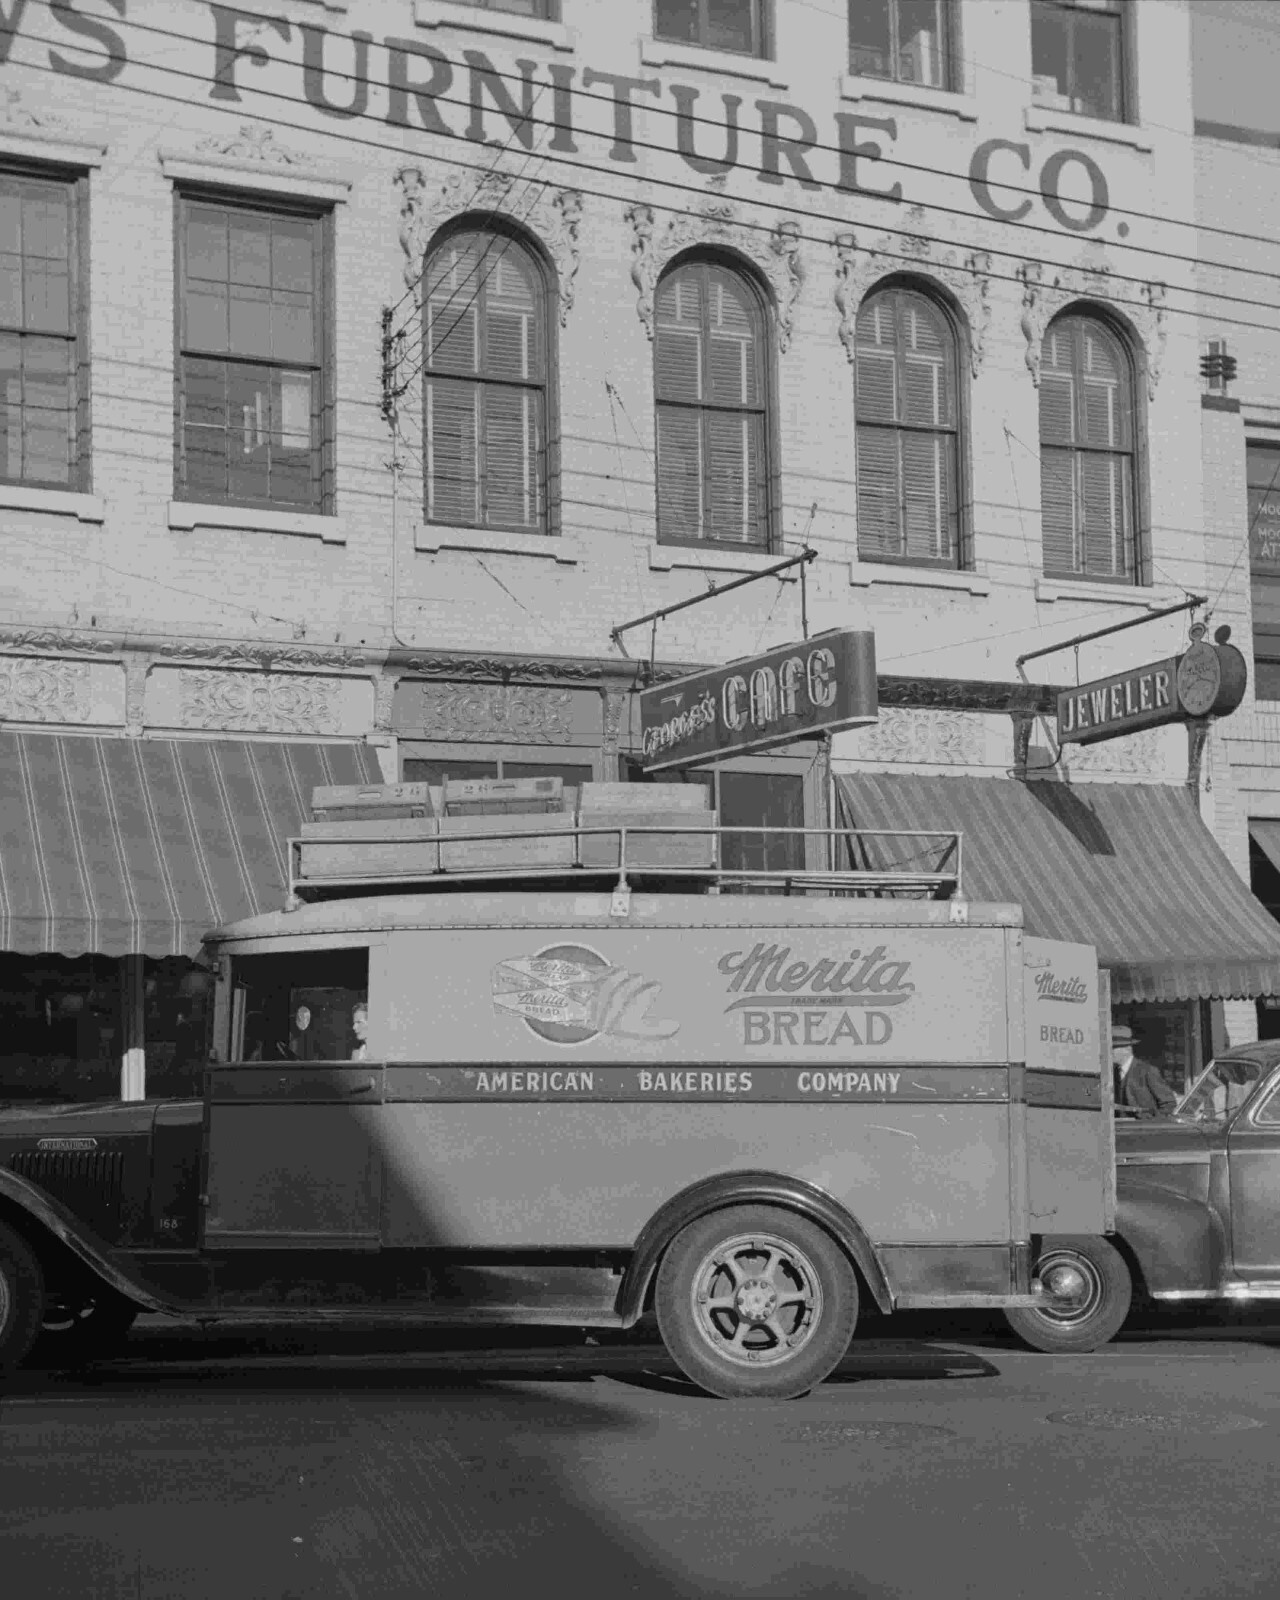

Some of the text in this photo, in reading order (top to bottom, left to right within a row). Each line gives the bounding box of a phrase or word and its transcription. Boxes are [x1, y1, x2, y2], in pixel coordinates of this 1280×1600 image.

[208, 3, 903, 204] FURNITURE
[969, 137, 1130, 238] CO.
[722, 648, 837, 732] CAFE
[1062, 670, 1170, 732] JEWELER
[717, 943, 916, 993] Merita
[517, 991, 569, 1007] Merita
[1034, 971, 1088, 999] Merita
[524, 1005, 561, 1015] BREAD
[743, 1011, 894, 1046] BREAD
[1040, 1024, 1085, 1045] BREAD
[475, 1070, 901, 1093] AMERICAN BAKERIES COMPANY
[159, 1217, 179, 1230] 168
